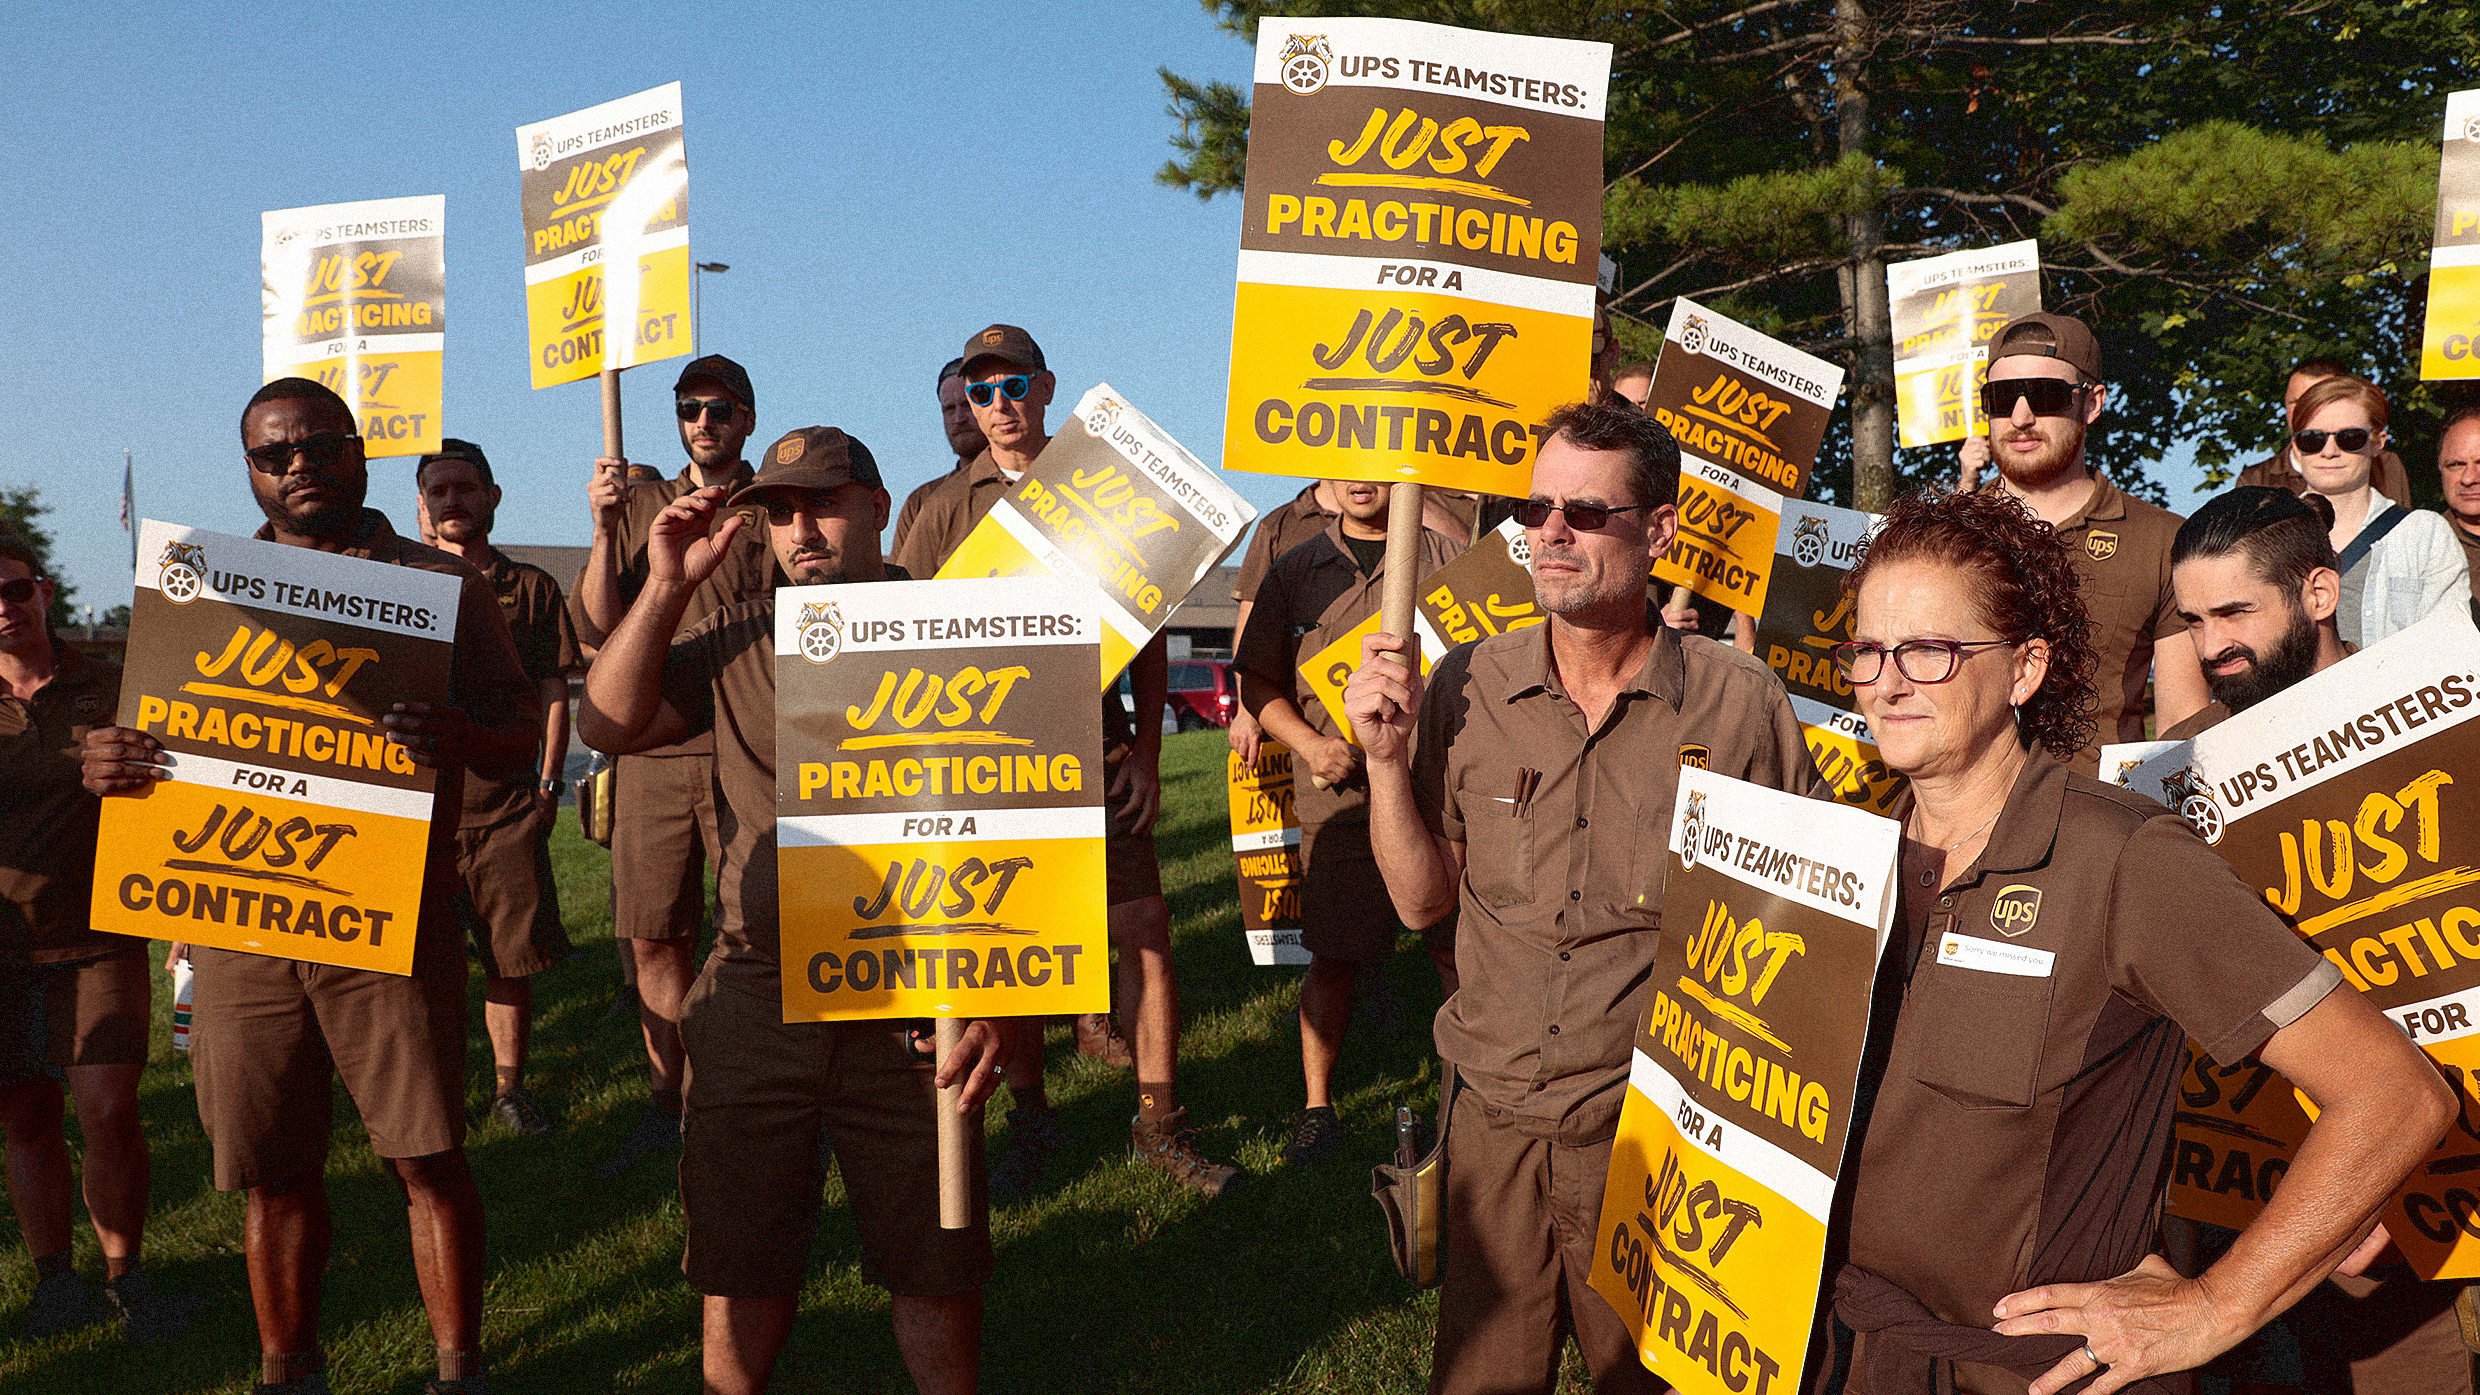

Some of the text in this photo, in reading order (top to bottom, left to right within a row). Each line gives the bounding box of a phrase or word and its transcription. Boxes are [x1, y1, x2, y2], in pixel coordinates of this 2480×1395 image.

[1340, 55, 1587, 110] UPS TEAMSTERS:
[557, 110, 673, 153] UPS TEAMSTERS:
[1327, 107, 1531, 179] JUST
[553, 146, 646, 205] JUST
[336, 218, 433, 238] TEAMSTERS:
[533, 198, 677, 255] PRACTG
[1266, 193, 1579, 265] PRACTICING
[306, 250, 403, 295] JUST
[1377, 265, 1463, 291] FOR A
[1922, 281, 2007, 320] JUST
[1924, 271, 1948, 285] UPS
[294, 302, 432, 336] RACTICING
[357, 340, 367, 350] A
[543, 313, 677, 369] CONTACT
[1312, 307, 1518, 381] JUST
[1709, 338, 1827, 400] UPS TEAMSTERS:
[1692, 374, 1792, 431] JUST
[780, 444, 801, 460] ups
[1655, 407, 1799, 490] PRACTICING
[1071, 465, 1180, 538] JUST
[1112, 425, 1230, 532] UPS TEAMSTERS:
[1700, 465, 1740, 490] FOR A
[1018, 478, 1163, 615] PRACTICING
[1659, 539, 1761, 597] NTRACT
[2089, 538, 2114, 556] ups
[212, 570, 438, 632] UPS TEAMSTERS:
[851, 614, 1082, 643] UPS TEAMSTERS:
[195, 625, 380, 698] JUST
[845, 665, 1031, 730] JUST
[1829, 712, 1869, 738] FOR
[136, 694, 417, 776] PRACTICING
[2219, 673, 2480, 809] UPS TEAMSTERS:
[232, 768, 308, 797] FOR A
[799, 753, 1082, 800] PRACTICING
[902, 816, 977, 837] FOR A
[1246, 789, 1294, 826] JUST
[172, 804, 358, 872] JUST
[1240, 852, 1299, 878] ACTICING
[2265, 769, 2454, 916] JUST
[852, 856, 1034, 920] JUST
[1704, 825, 1864, 910] UPS TEAMSTERS:
[118, 873, 393, 947] CONTRACT
[1994, 899, 2035, 928] ups
[807, 944, 1082, 994] CONTRACT
[1686, 899, 1806, 1007] JUST
[2402, 1002, 2473, 1040] FOR
[1649, 990, 1831, 1145] PRACTICING
[1677, 1098, 1723, 1151] FOR A
[1645, 1146, 1762, 1268] JUST
[1611, 1221, 1780, 1395] CONTRACT
